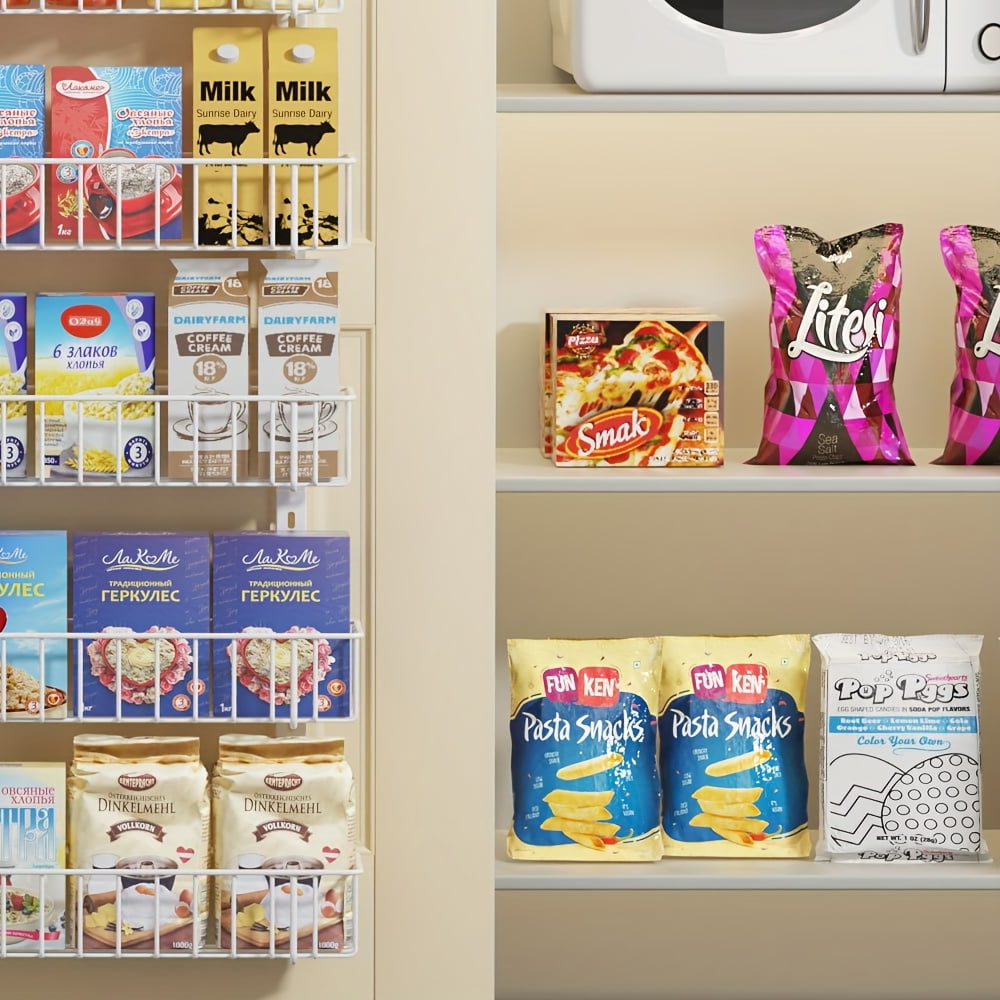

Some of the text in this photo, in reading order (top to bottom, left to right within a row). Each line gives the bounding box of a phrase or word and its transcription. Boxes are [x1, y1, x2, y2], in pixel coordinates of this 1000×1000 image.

[200, 81, 256, 102] Milk
[276, 81, 332, 102] Milk
[187, 334, 232, 343] COFFEE
[277, 334, 322, 343] COFFEE
[52, 343, 118, 358] 6 злаков
[188, 343, 232, 352] CREAM
[278, 343, 322, 352] CREAM
[66, 360, 105, 370] хлопья
[577, 409, 649, 456] Smak
[817, 433, 838, 444] Sea
[817, 444, 837, 454] Salt
[109, 579, 172, 588] ТРАДИЦИОННЫЙ
[249, 579, 313, 588] ТРАДИЦИОННЫЙ
[101, 590, 181, 602] ГЕРКУЛЕС
[241, 590, 321, 602] ГЕРКУЛЕС
[546, 673, 576, 693] FUN
[694, 670, 724, 690] FUN
[834, 677, 894, 704] Pop
[521, 711, 645, 744] Pasta Snacks
[670, 706, 792, 741] Pasta Snacks
[857, 735, 944, 747] Color Your Own
[98, 797, 176, 814] DINKELMEHL
[244, 797, 322, 814] DINKELMEHL
[117, 821, 156, 832] VOLLKORN
[263, 821, 302, 832] VOLLKORN
